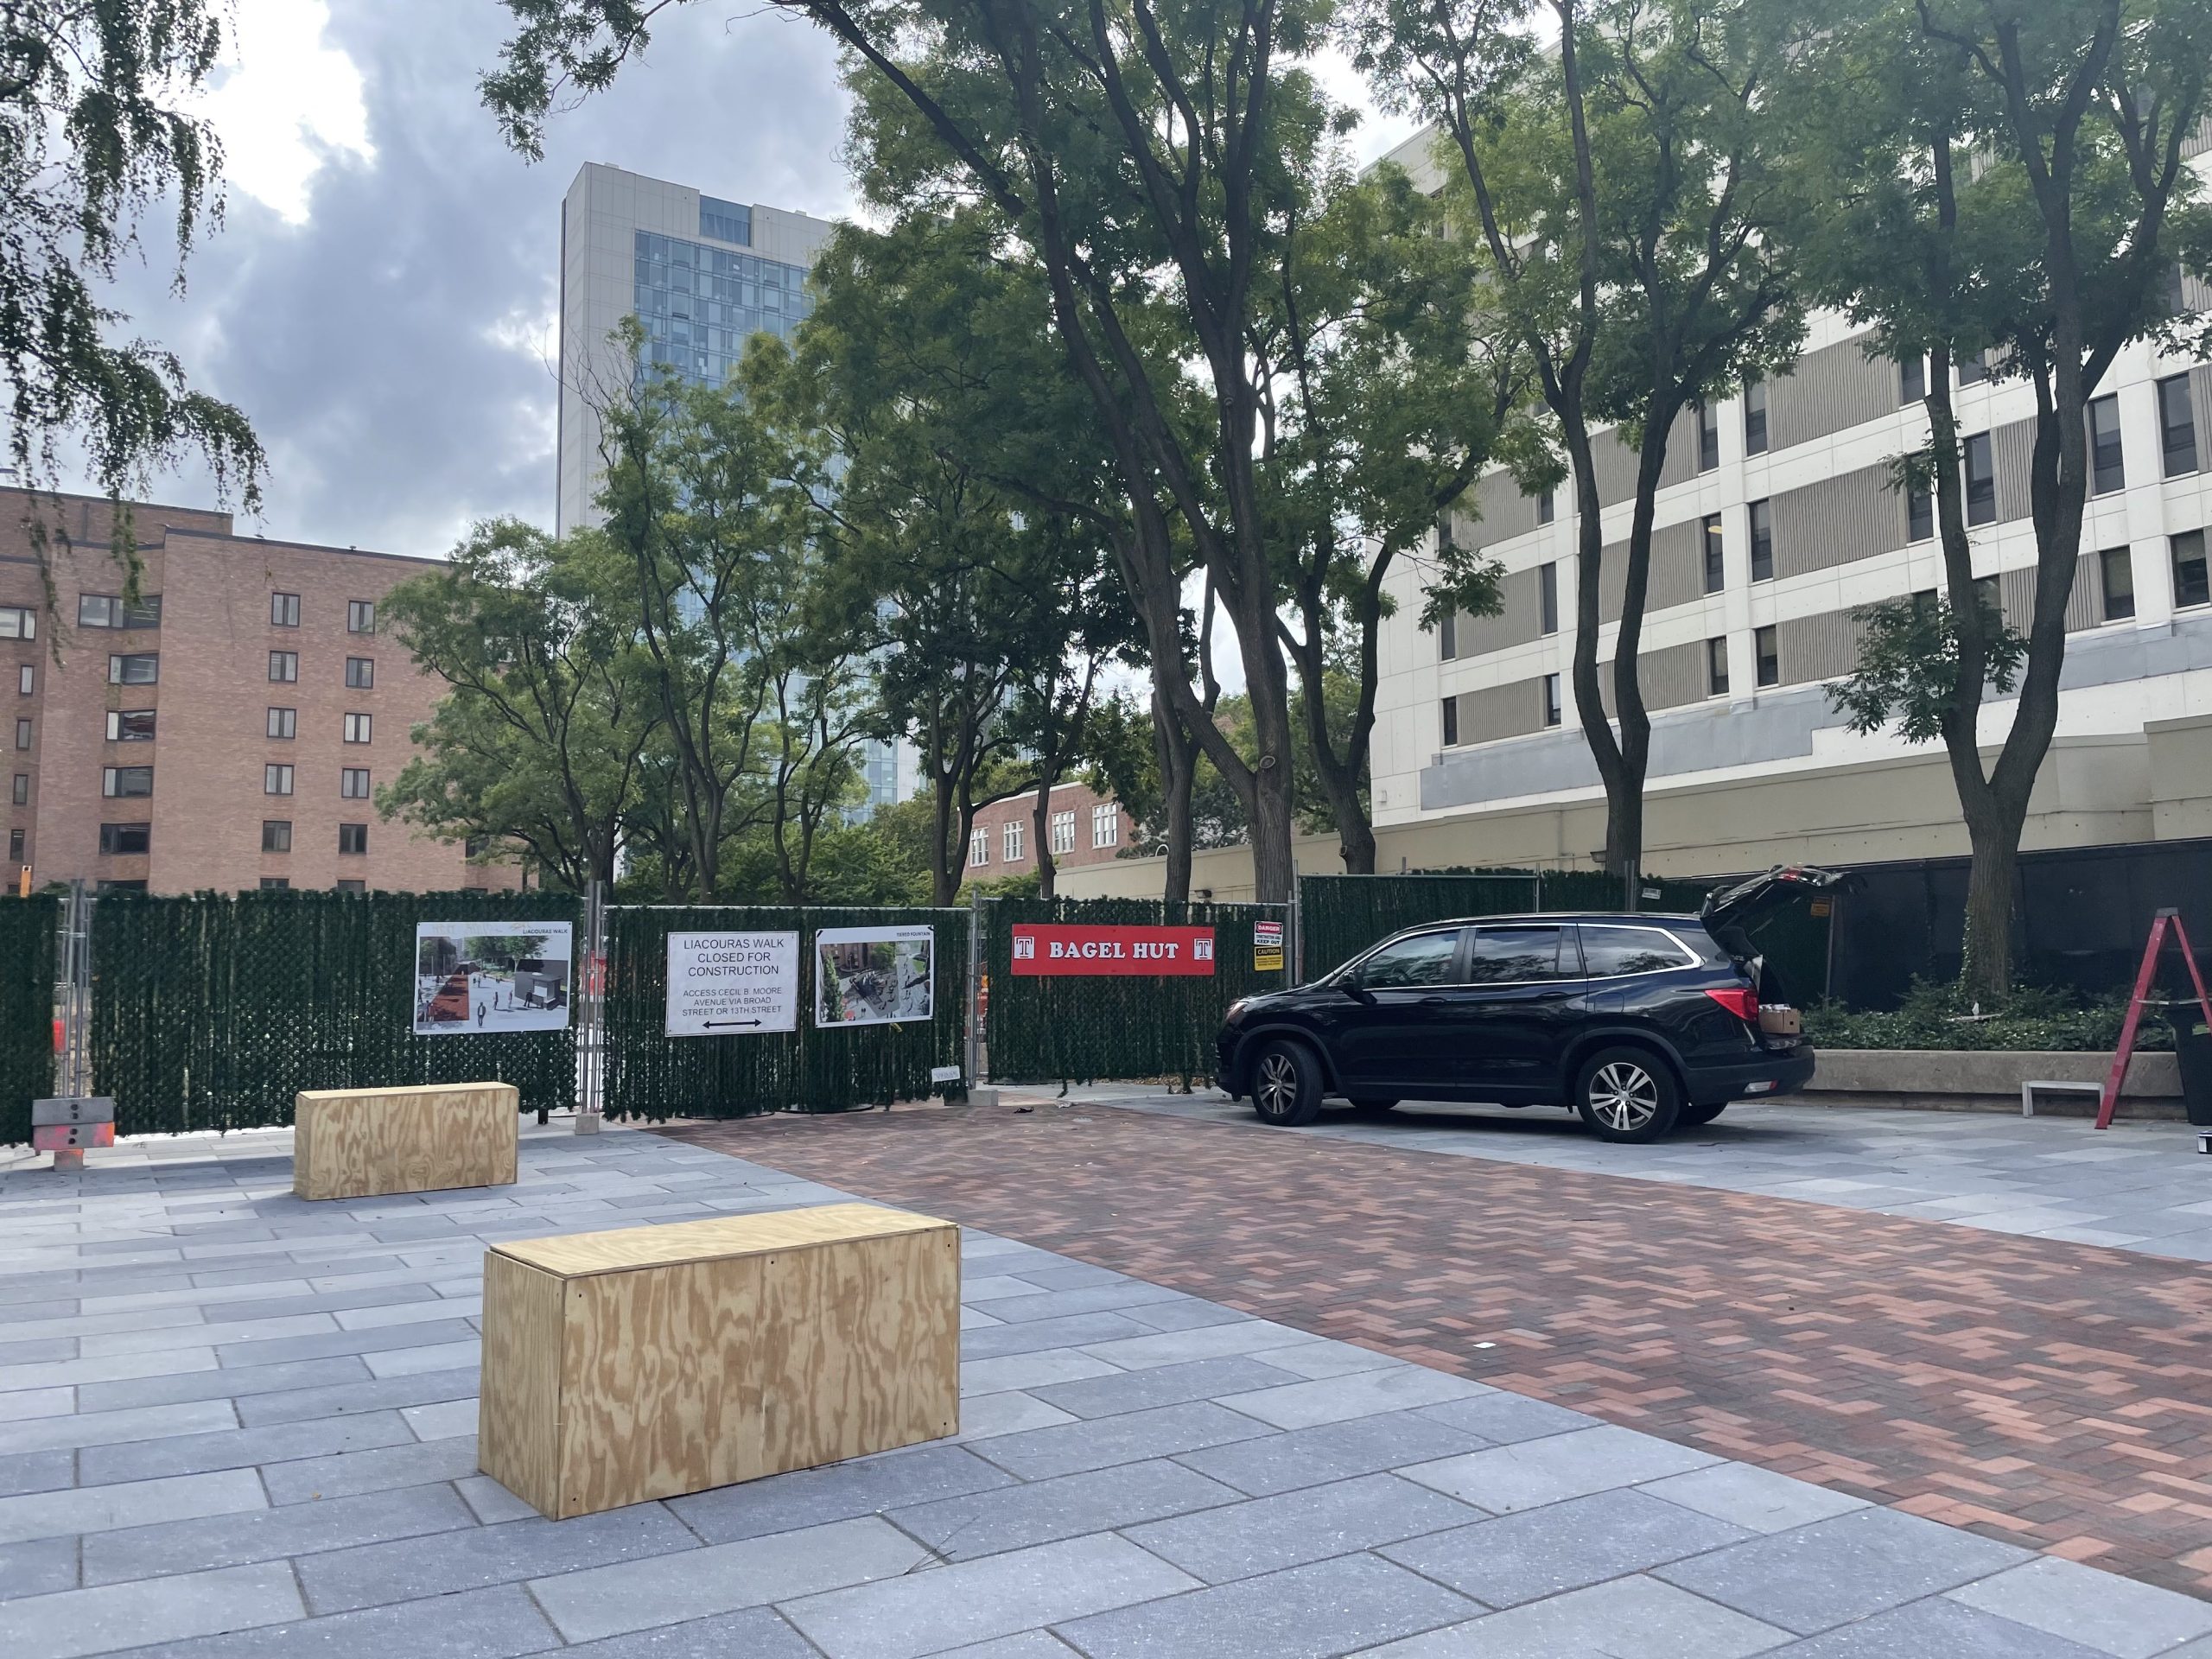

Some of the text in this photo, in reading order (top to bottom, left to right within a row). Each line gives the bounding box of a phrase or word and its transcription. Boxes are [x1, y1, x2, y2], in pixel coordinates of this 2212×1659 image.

[683, 938, 785, 950] LIACOURAS WALK
[1049, 941, 1126, 959] BAGEL
[1132, 942, 1179, 959] HUT
[697, 951, 772, 963] CLOSED FOR
[688, 965, 779, 976] CONSTRUCTION
[683, 988, 716, 997] ACCESS
[718, 988, 741, 996] CECIL
[753, 987, 782, 995] MOORE
[693, 998, 727, 1007] AVENUE
[752, 1005, 782, 1014] STREET
